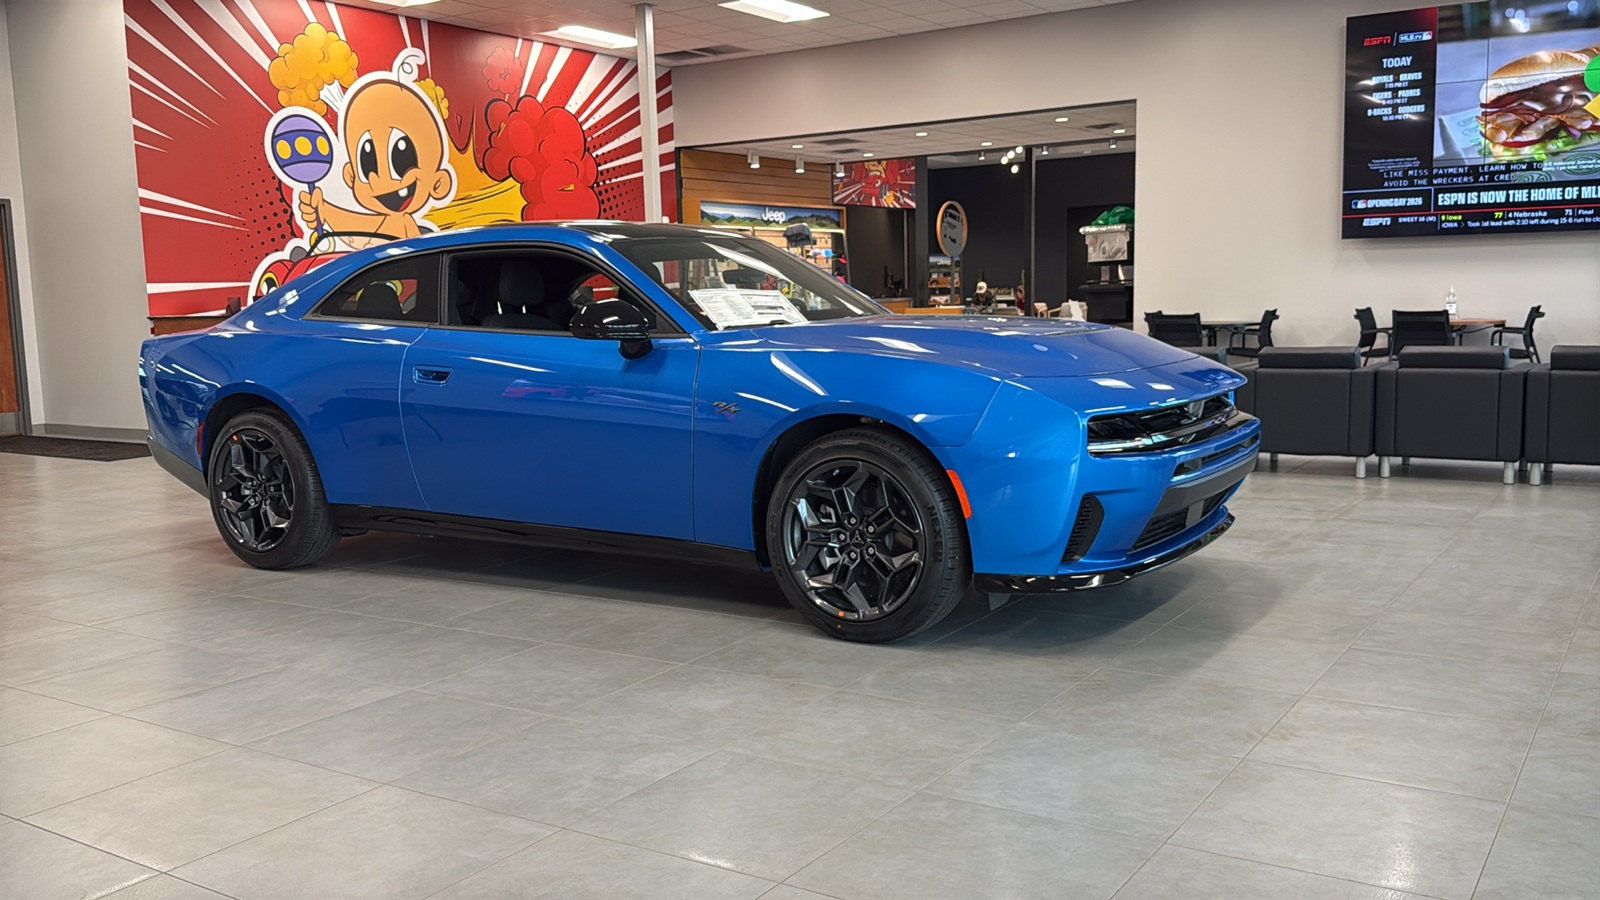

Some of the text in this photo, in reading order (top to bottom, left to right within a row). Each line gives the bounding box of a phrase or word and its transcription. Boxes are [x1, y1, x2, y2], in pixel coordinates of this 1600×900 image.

[1363, 35, 1391, 46] ESPN
[1382, 56, 1412, 68] TODAY
[1367, 107, 1392, 116] D-BACKS
[1438, 193, 1465, 206] ESPN
[1468, 192, 1478, 204] IS
[1480, 190, 1506, 203] NOW
[1509, 189, 1528, 202] THE
[1531, 188, 1563, 201] HOME
[1565, 187, 1579, 199] OF
[1368, 199, 1393, 208] OPENING
[762, 207, 786, 224] Jeep
[1363, 217, 1391, 226] ESPN
[928, 504, 944, 564] NEXEN
